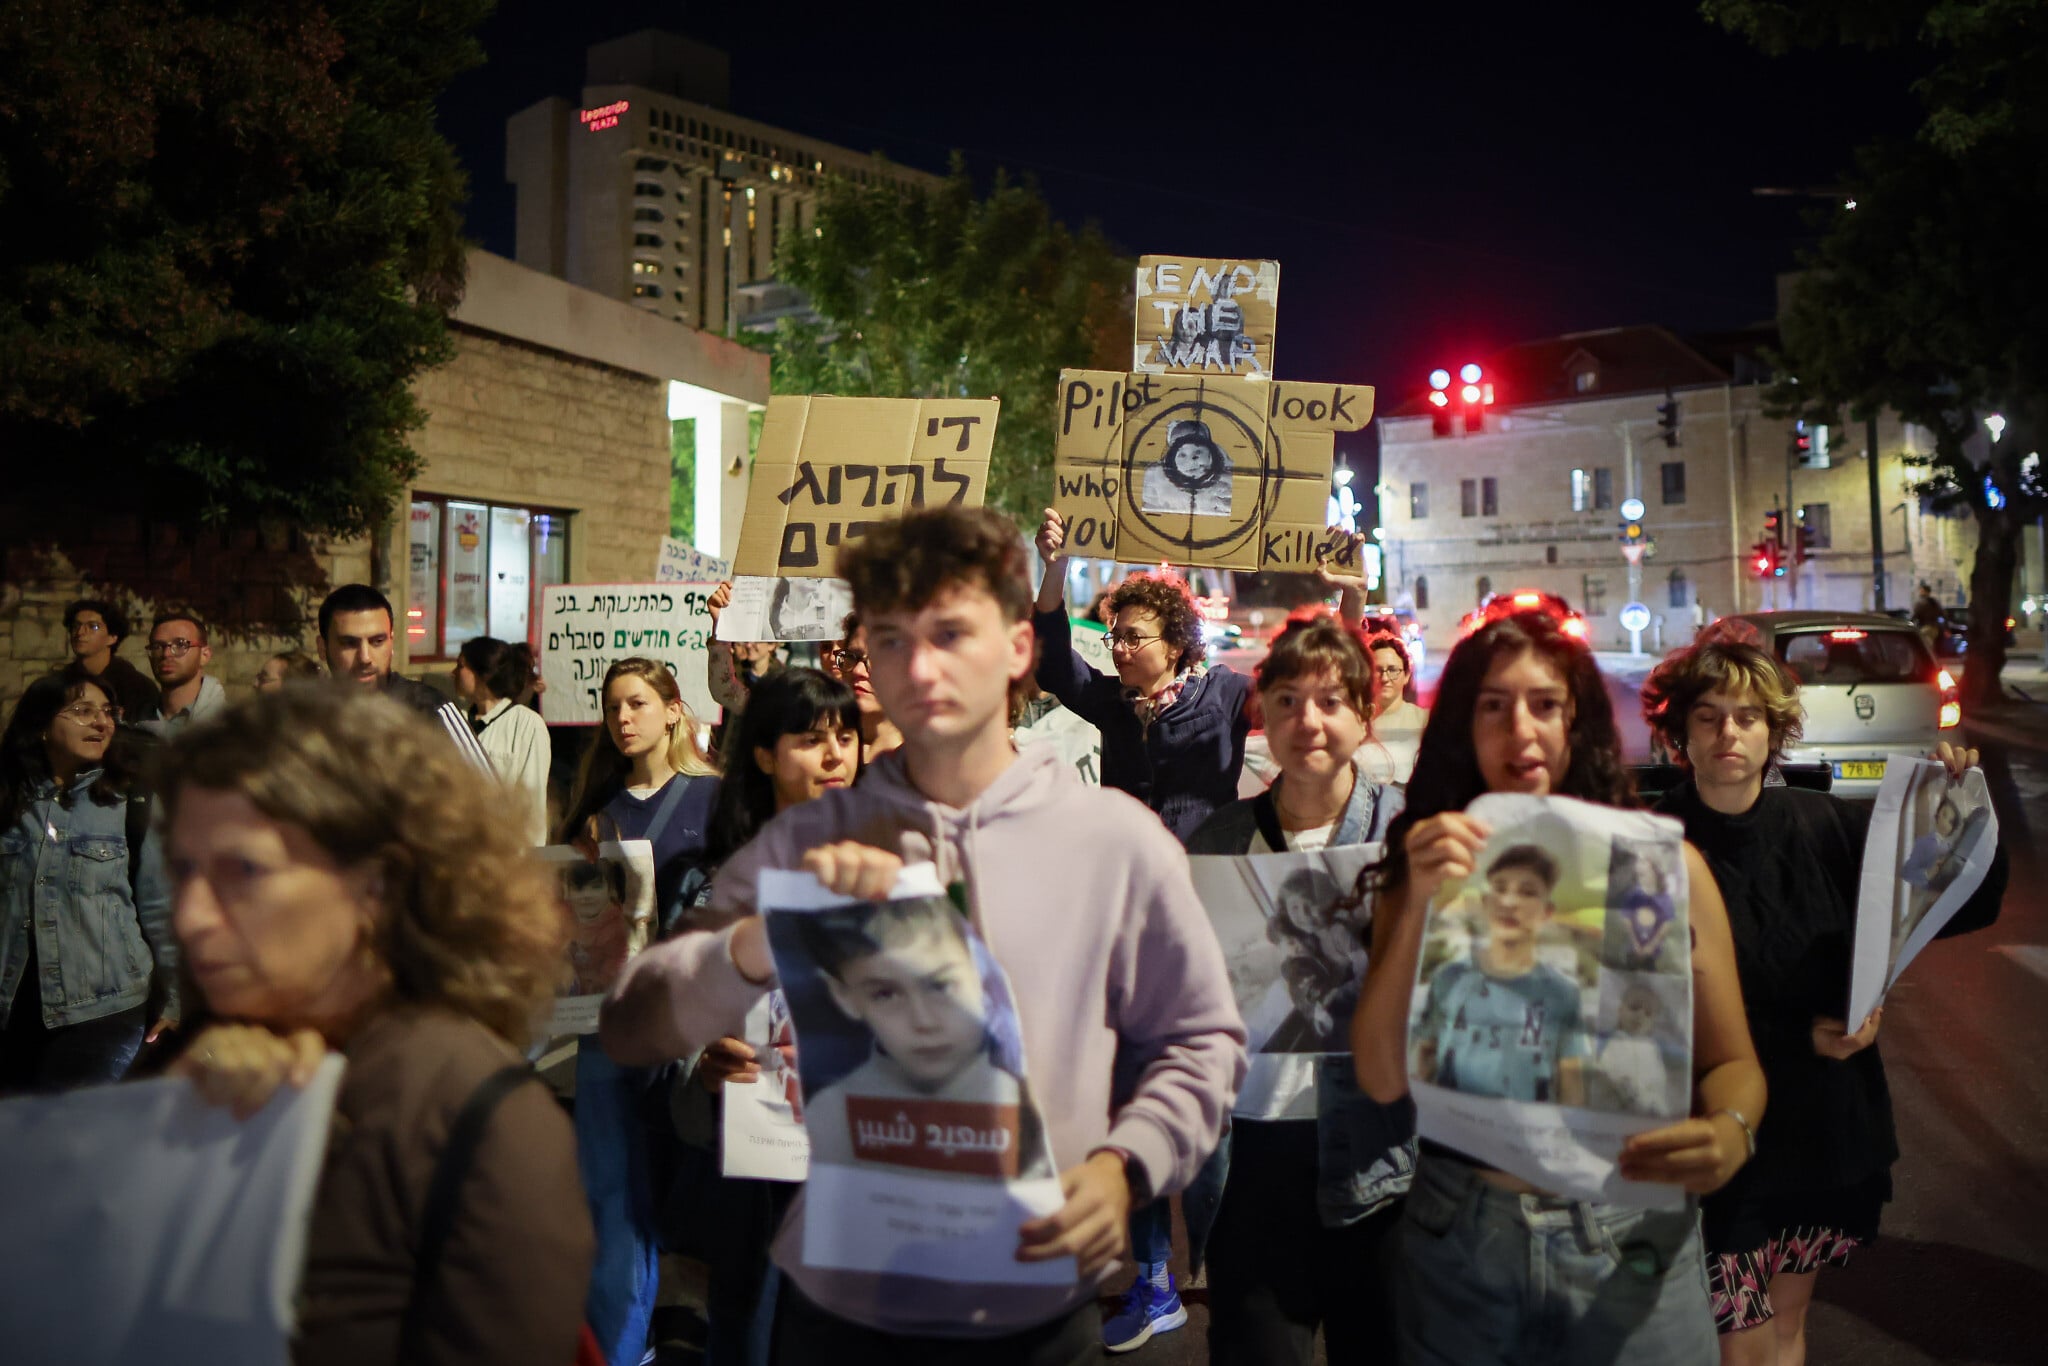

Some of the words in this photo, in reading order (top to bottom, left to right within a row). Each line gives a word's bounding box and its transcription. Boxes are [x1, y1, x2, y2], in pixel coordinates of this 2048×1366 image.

[590, 115, 618, 132] PLAZA
[1156, 264, 1256, 296] END
[1152, 299, 1242, 332] THE
[1156, 334, 1262, 372] WAR
[1063, 374, 1161, 435] Pilot
[927, 416, 980, 451] די
[777, 457, 970, 507] להרוג
[555, 595, 580, 614] בני
[549, 622, 605, 650] סובלים
[614, 630, 670, 648] חודשים
